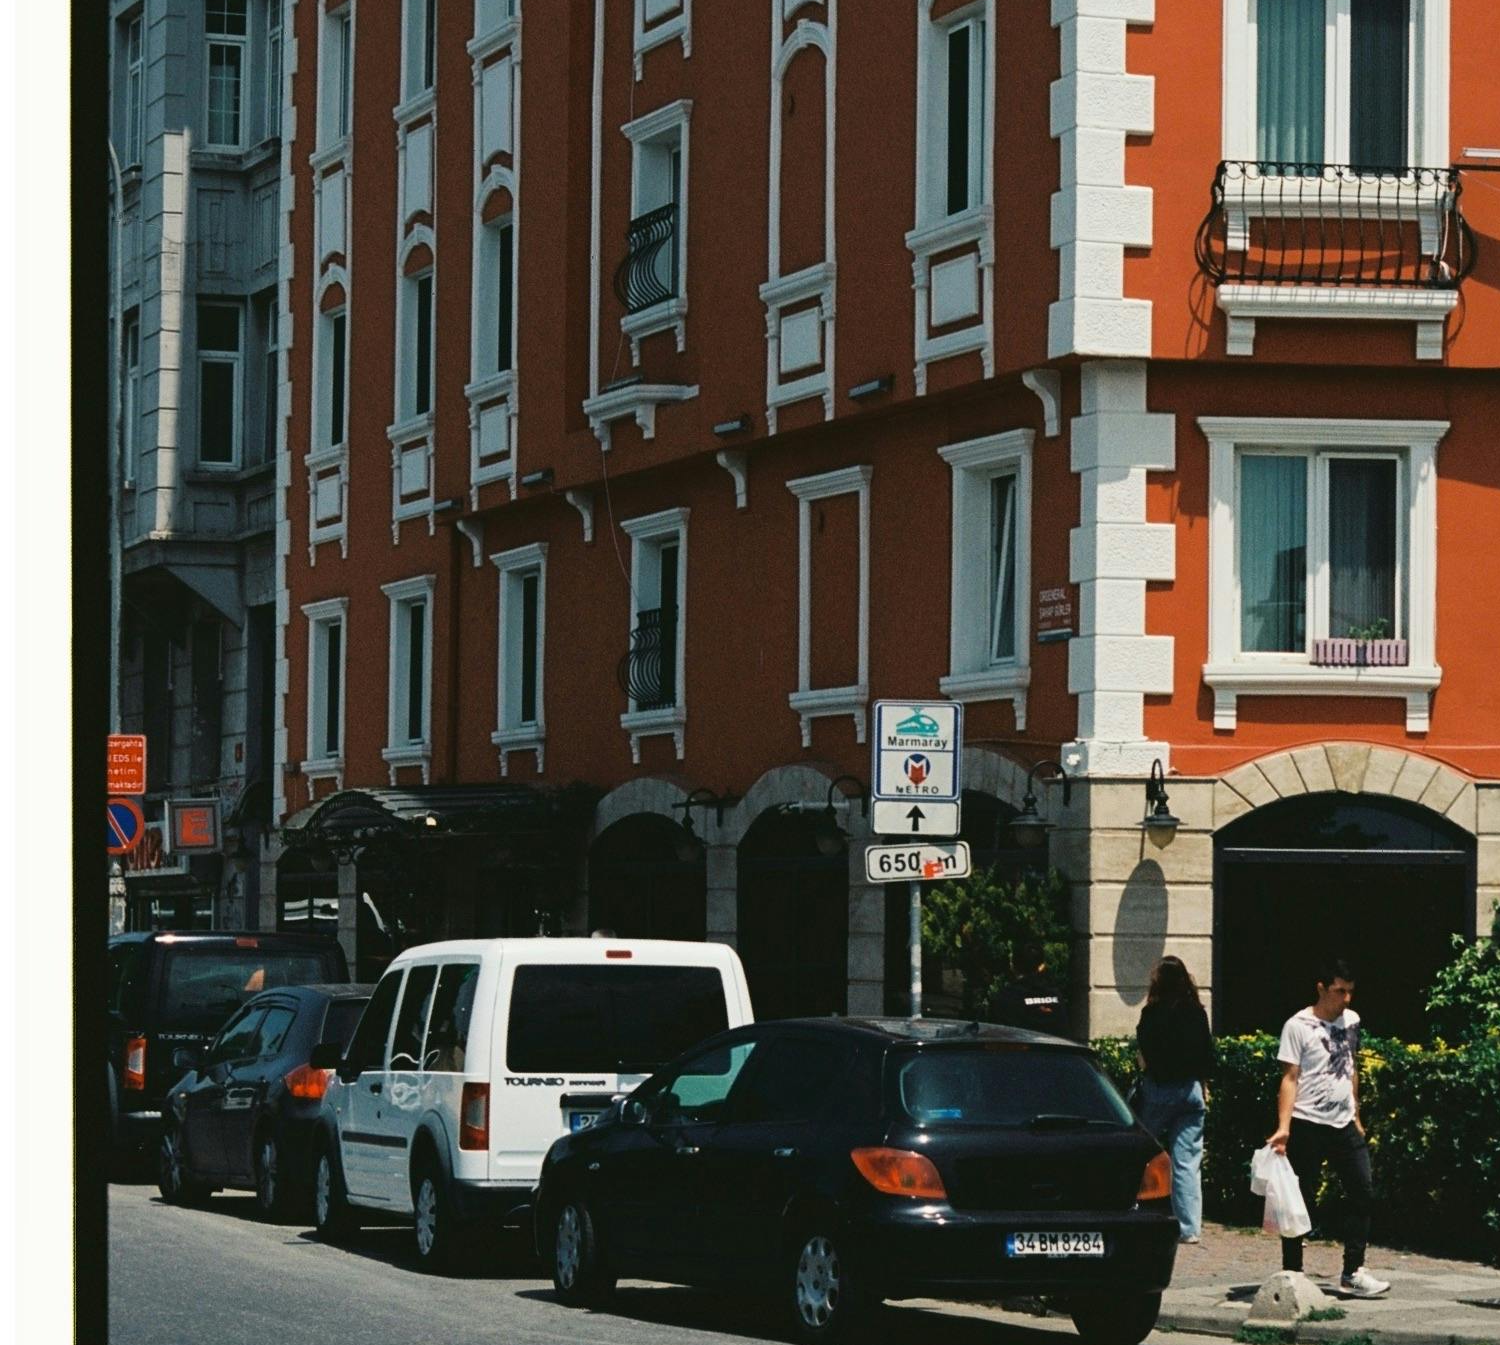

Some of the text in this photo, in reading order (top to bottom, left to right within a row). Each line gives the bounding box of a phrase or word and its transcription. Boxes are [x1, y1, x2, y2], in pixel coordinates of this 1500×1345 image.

[887, 735, 948, 749] Marmaray
[113, 753, 129, 762] EDS
[896, 785, 939, 795] METRO
[879, 852, 921, 873] 650
[503, 1076, 565, 1087] TOURNEO
[1015, 1233, 1101, 1252] 34 BM 8284
